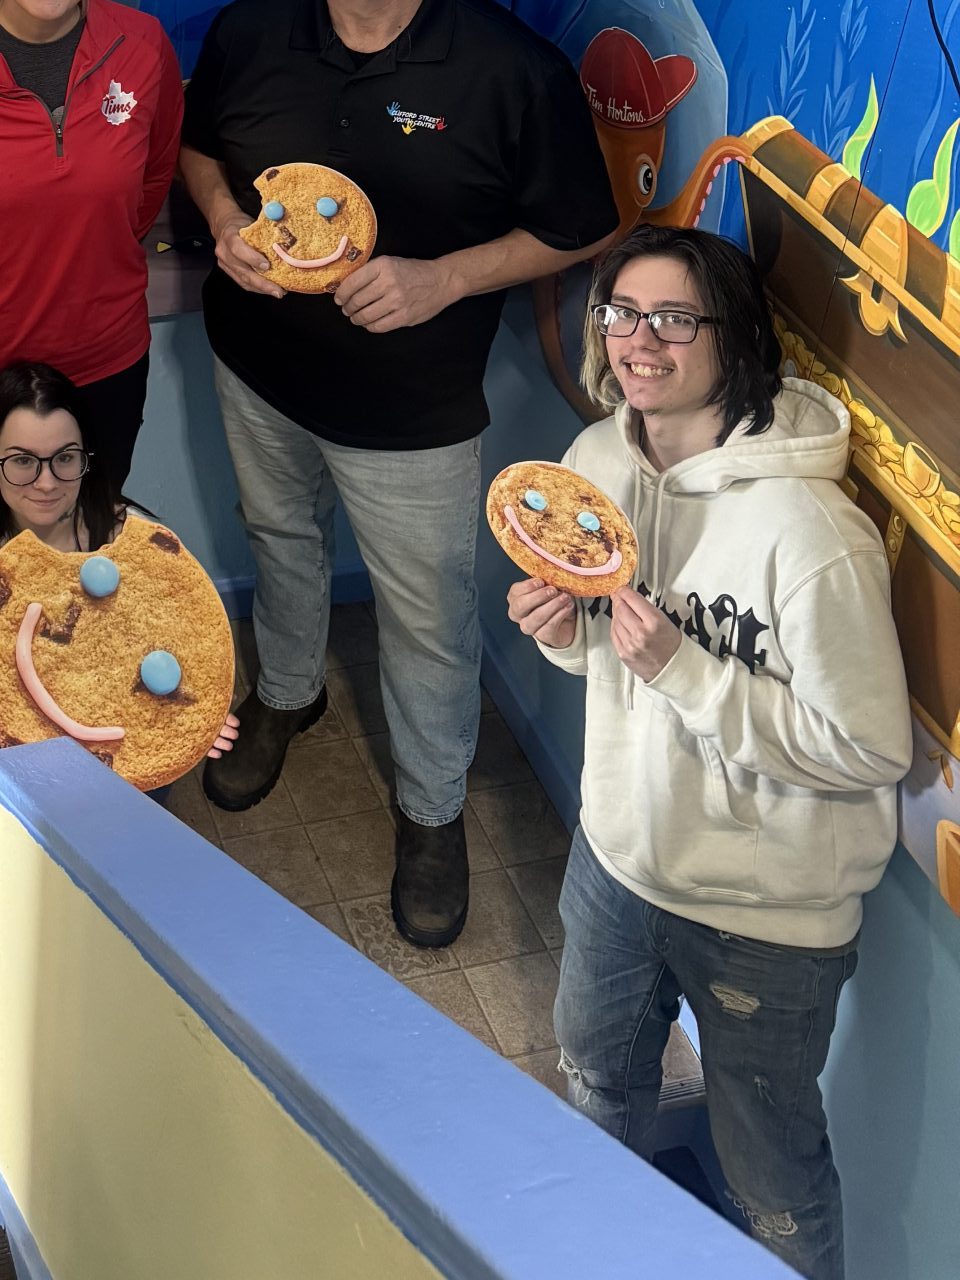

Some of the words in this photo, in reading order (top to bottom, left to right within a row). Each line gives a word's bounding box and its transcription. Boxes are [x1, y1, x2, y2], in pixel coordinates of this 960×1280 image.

[103, 95, 131, 115] Tims
[586, 83, 603, 113] Tim
[392, 110, 417, 118] CLIFFORD
[418, 114, 441, 124] STREET
[414, 120, 436, 129] CENTRE
